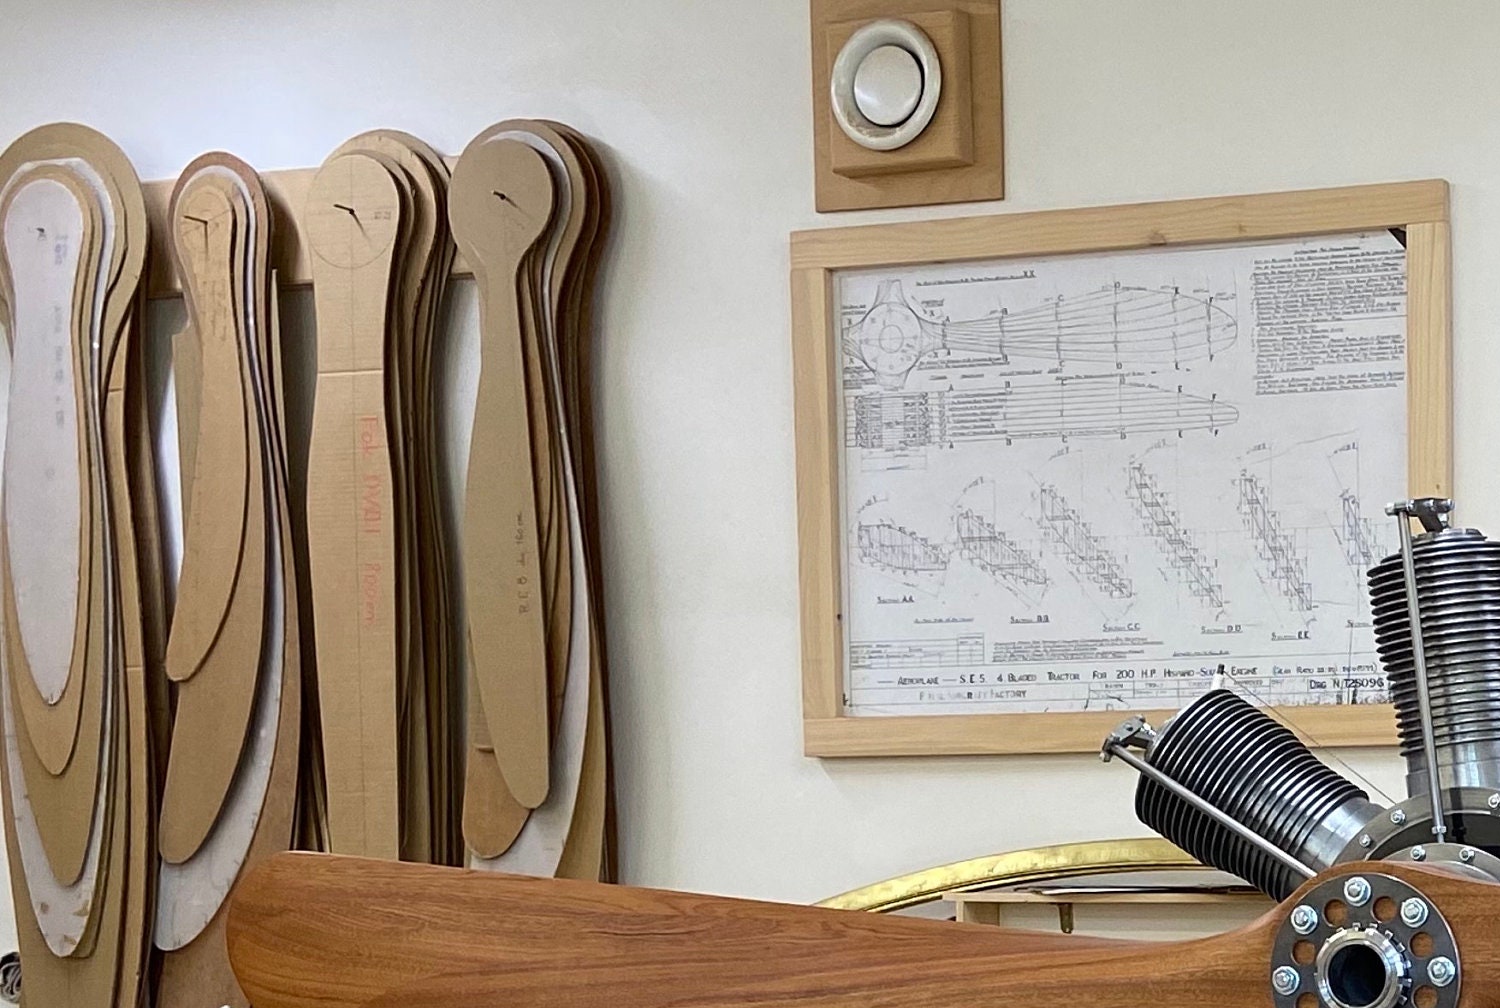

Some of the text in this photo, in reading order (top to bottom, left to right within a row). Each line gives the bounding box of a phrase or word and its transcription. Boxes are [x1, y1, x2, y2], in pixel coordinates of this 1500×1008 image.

[1047, 671, 1080, 681] TRACTOR
[1116, 669, 1135, 679] 200
[990, 688, 1027, 699] FACTORY
